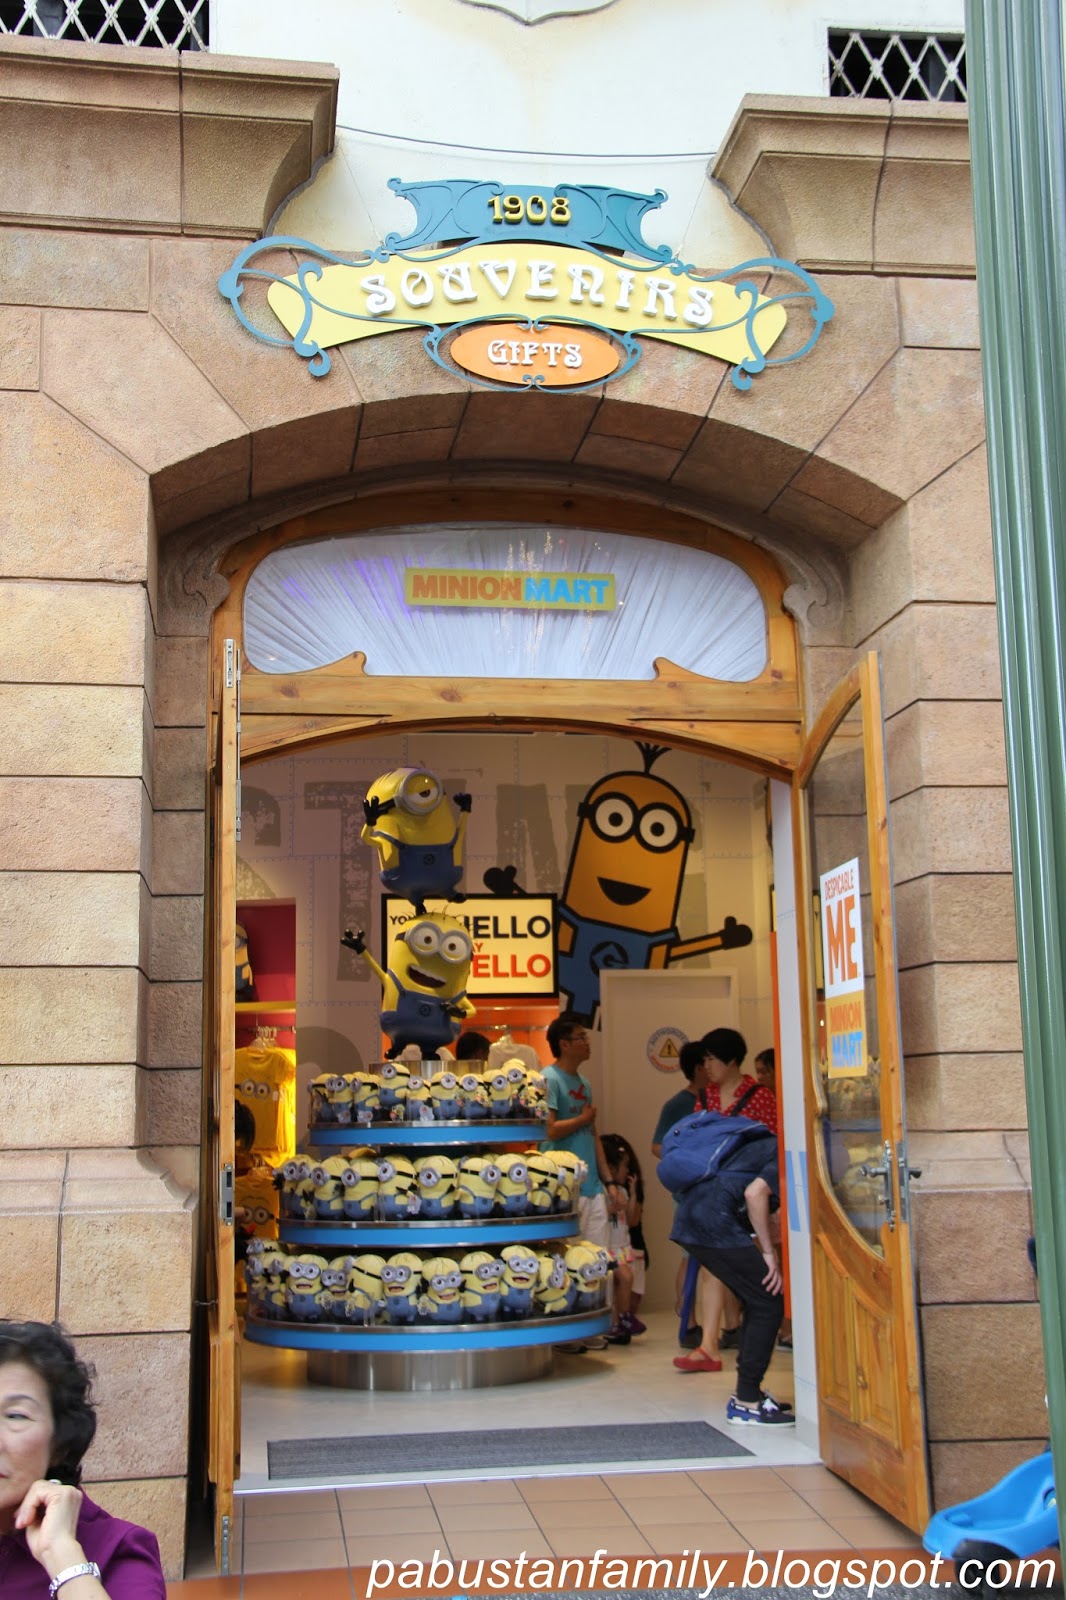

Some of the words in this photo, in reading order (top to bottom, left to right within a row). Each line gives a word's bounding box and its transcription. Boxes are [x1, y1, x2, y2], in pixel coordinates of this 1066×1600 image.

[487, 195, 571, 224] 1908
[361, 260, 714, 326] SOUVENIRS
[487, 339, 583, 369] GIFTS
[412, 575, 521, 600] MINION
[525, 577, 609, 604] MART
[825, 868, 854, 901] DESPICABLE
[826, 894, 857, 986] ME
[830, 1001, 862, 1034] MINION
[831, 1031, 863, 1068] MART
